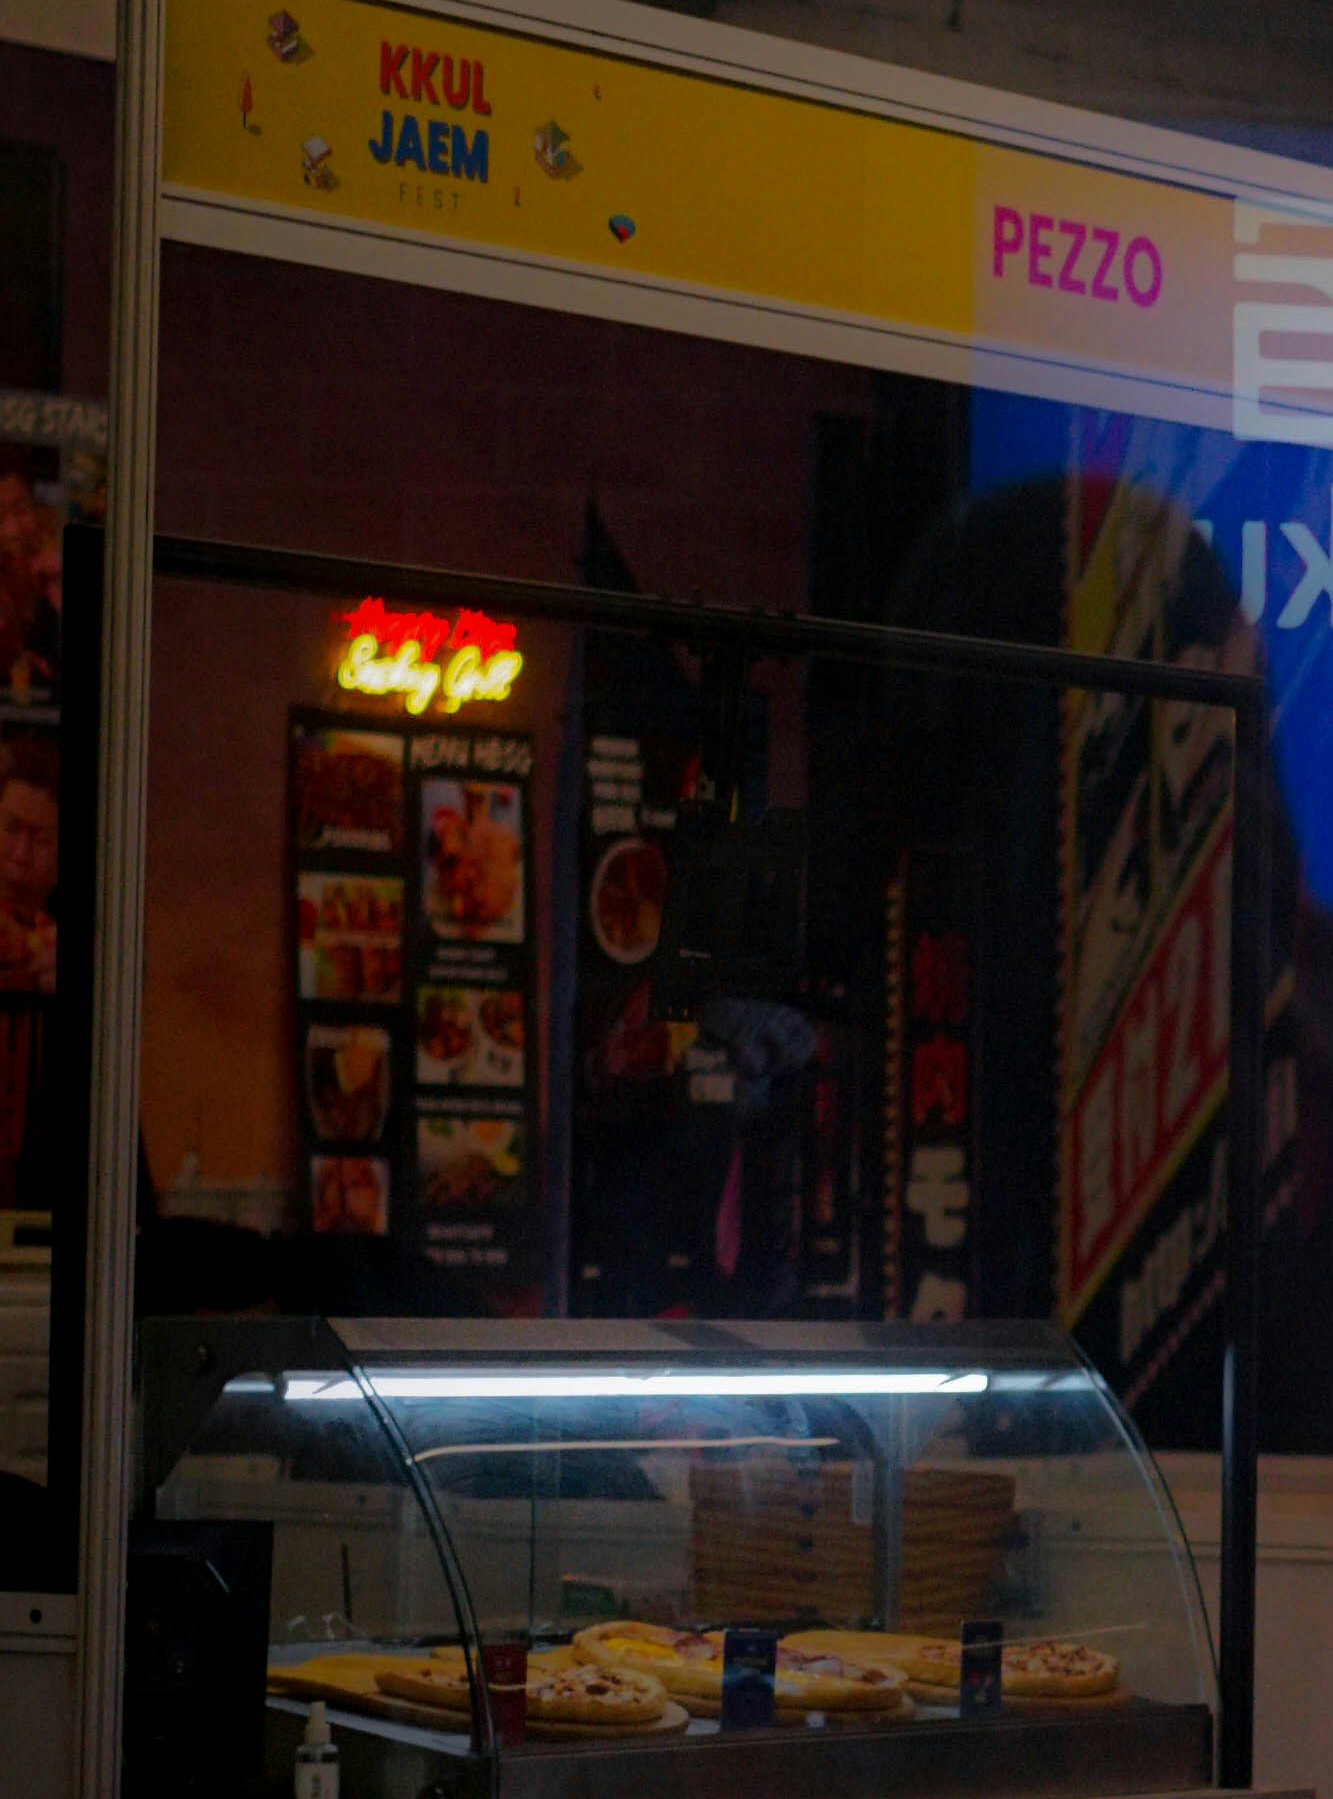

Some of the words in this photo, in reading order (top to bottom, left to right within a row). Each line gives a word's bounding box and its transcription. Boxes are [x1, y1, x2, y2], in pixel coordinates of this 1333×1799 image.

[380, 40, 492, 117] KKUL
[368, 109, 488, 186] JAEM
[994, 206, 1162, 307] PEZZO
